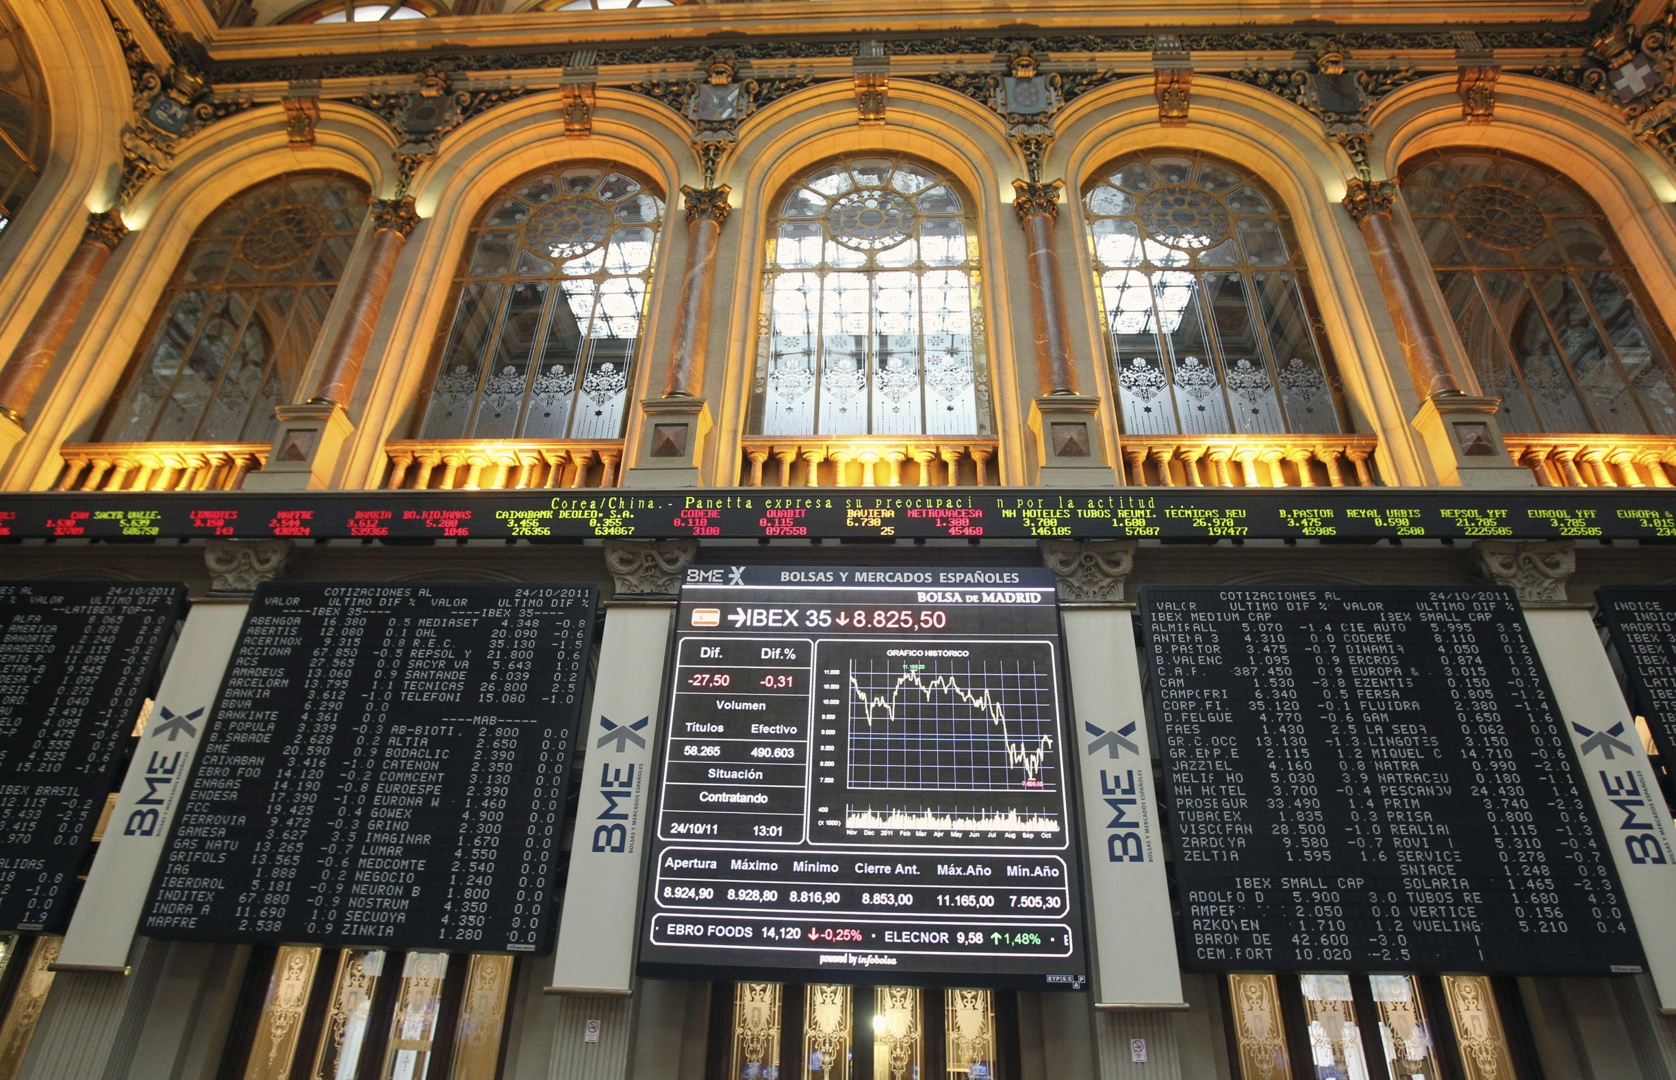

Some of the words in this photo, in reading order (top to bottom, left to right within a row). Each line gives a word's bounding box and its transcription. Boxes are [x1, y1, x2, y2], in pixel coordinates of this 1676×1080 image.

[685, 497, 752, 508] Panetta
[765, 499, 832, 508] expresa
[846, 499, 862, 508] su
[1017, 499, 1043, 508] por
[1059, 496, 1074, 508] la
[1088, 497, 1155, 508] actitud
[496, 510, 553, 519] CAIXABANK
[681, 510, 720, 519] CODERE
[767, 509, 806, 519] QUABIT
[847, 509, 894, 517] BAVIERA
[1002, 509, 1016, 517] NH
[1023, 509, 1070, 518] HOTELES
[1077, 510, 1111, 518] TUBOS
[1117, 510, 1156, 518] REUNI.
[1279, 509, 1333, 517] B.PASTOR
[1440, 509, 1482, 517] REPSOL
[507, 519, 539, 527] 3.456
[674, 517, 709, 526] 8.110
[760, 517, 793, 526] 0.115
[847, 518, 881, 526] 6.730
[1023, 518, 1057, 526] 3.700
[1112, 518, 1145, 526] 1.680
[1287, 518, 1321, 526] 3.475
[1456, 518, 1497, 526] 21.785
[687, 570, 724, 582] BME
[781, 572, 833, 582] BOLSAS
[839, 572, 848, 582] Y
[855, 572, 932, 583] MERCADOS
[940, 571, 1019, 583] ESPAÑOLES
[324, 588, 411, 596] COTIZACIONES
[418, 588, 432, 596] AL
[515, 589, 588, 597] 24/10/2011
[917, 592, 963, 602] BOLSA
[982, 592, 1041, 603] MADRID
[1220, 592, 1316, 600] COTIZACIONES
[1325, 592, 1341, 600] AL
[1429, 592, 1509, 600] 24/10/2011
[250, 617, 301, 625] ABENGOA
[323, 617, 366, 626] 16.380
[389, 618, 411, 626] 0.5
[418, 618, 478, 627] MEDIASET
[502, 619, 539, 627] 4.348
[556, 620, 585, 628] -0.8
[746, 609, 799, 626] IBEX
[805, 610, 831, 627] 35
[853, 610, 946, 631] 8.825,50
[1621, 623, 1671, 631] MADRID
[700, 647, 722, 658] Dif.
[761, 648, 796, 659] Dif.%
[1349, 656, 1398, 665] ERCROS
[1441, 656, 1482, 665] 0.874
[1509, 656, 1533, 665] 1.3
[232, 668, 285, 677] AMADEUS
[307, 669, 352, 678] 13.060
[374, 670, 397, 678] 0.9
[405, 670, 467, 680] SANTANDE
[490, 672, 529, 681] 6.039
[554, 673, 577, 681] 0.2
[688, 674, 730, 687] -27,50
[760, 675, 792, 688] -0,31
[1160, 678, 1184, 687] CAM
[1254, 678, 1294, 687] 1.530
[1357, 690, 1400, 699] FERSA
[1451, 690, 1493, 699] 0.805
[1511, 690, 1545, 699] -1.2
[716, 700, 766, 710] Volumen
[685, 722, 724, 732] Títulos
[751, 724, 797, 734] Efectivo
[1166, 725, 1200, 734] FAES
[1263, 725, 1304, 734] 1.430
[684, 746, 720, 756] 58.265
[751, 747, 794, 758] 490.603
[708, 769, 763, 779] Situación
[35, 786, 79, 796] BRASIL
[123, 751, 182, 836] BME
[376, 783, 442, 795] EUROESPE
[467, 786, 508, 796] 2.390
[534, 788, 558, 798] 0.0
[632, 795, 640, 826] MERCADOS
[636, 763, 644, 793] ESPAÑOLES
[699, 791, 768, 803] Contratando
[592, 763, 635, 853] BME
[1100, 770, 1144, 862] BME
[1599, 770, 1667, 864] BME
[670, 823, 717, 834] 24/10/11
[753, 826, 782, 836] 13:01
[366, 832, 431, 844] IMAGINAR
[458, 836, 499, 847] 1.670
[526, 838, 551, 848] 0.0
[665, 857, 717, 870] Apertura
[731, 859, 778, 871] Máximo
[793, 860, 839, 872] Mínimo
[855, 863, 891, 874] Cierre
[895, 864, 920, 874] Ant.
[937, 864, 991, 876] Máx.Año
[1007, 865, 1059, 877] Mín.Año
[1400, 864, 1456, 875] SNIACE
[1504, 865, 1550, 876] 1.248
[1578, 865, 1607, 876] 0.8
[1235, 878, 1271, 888] IBEX
[1281, 878, 1327, 888] SMALL
[1338, 878, 1364, 888] CAP
[664, 887, 714, 900] 8.924,90
[727, 889, 778, 903] 8.928,80
[789, 891, 840, 905] 8.816,90
[862, 893, 913, 907] 8.853,00
[937, 895, 994, 908] 11.165,00
[1009, 896, 1061, 909] 7.505,30
[667, 924, 704, 936] EBRO
[708, 925, 753, 937] FOODS
[762, 927, 801, 940] 14,120
[820, 929, 862, 942] -0,25%
[885, 931, 949, 943] ELECNOR
[957, 932, 983, 945] 9,58
[1004, 933, 1041, 946] 1,48%
[848, 953, 857, 966] by
[858, 955, 897, 967] infobolsa
